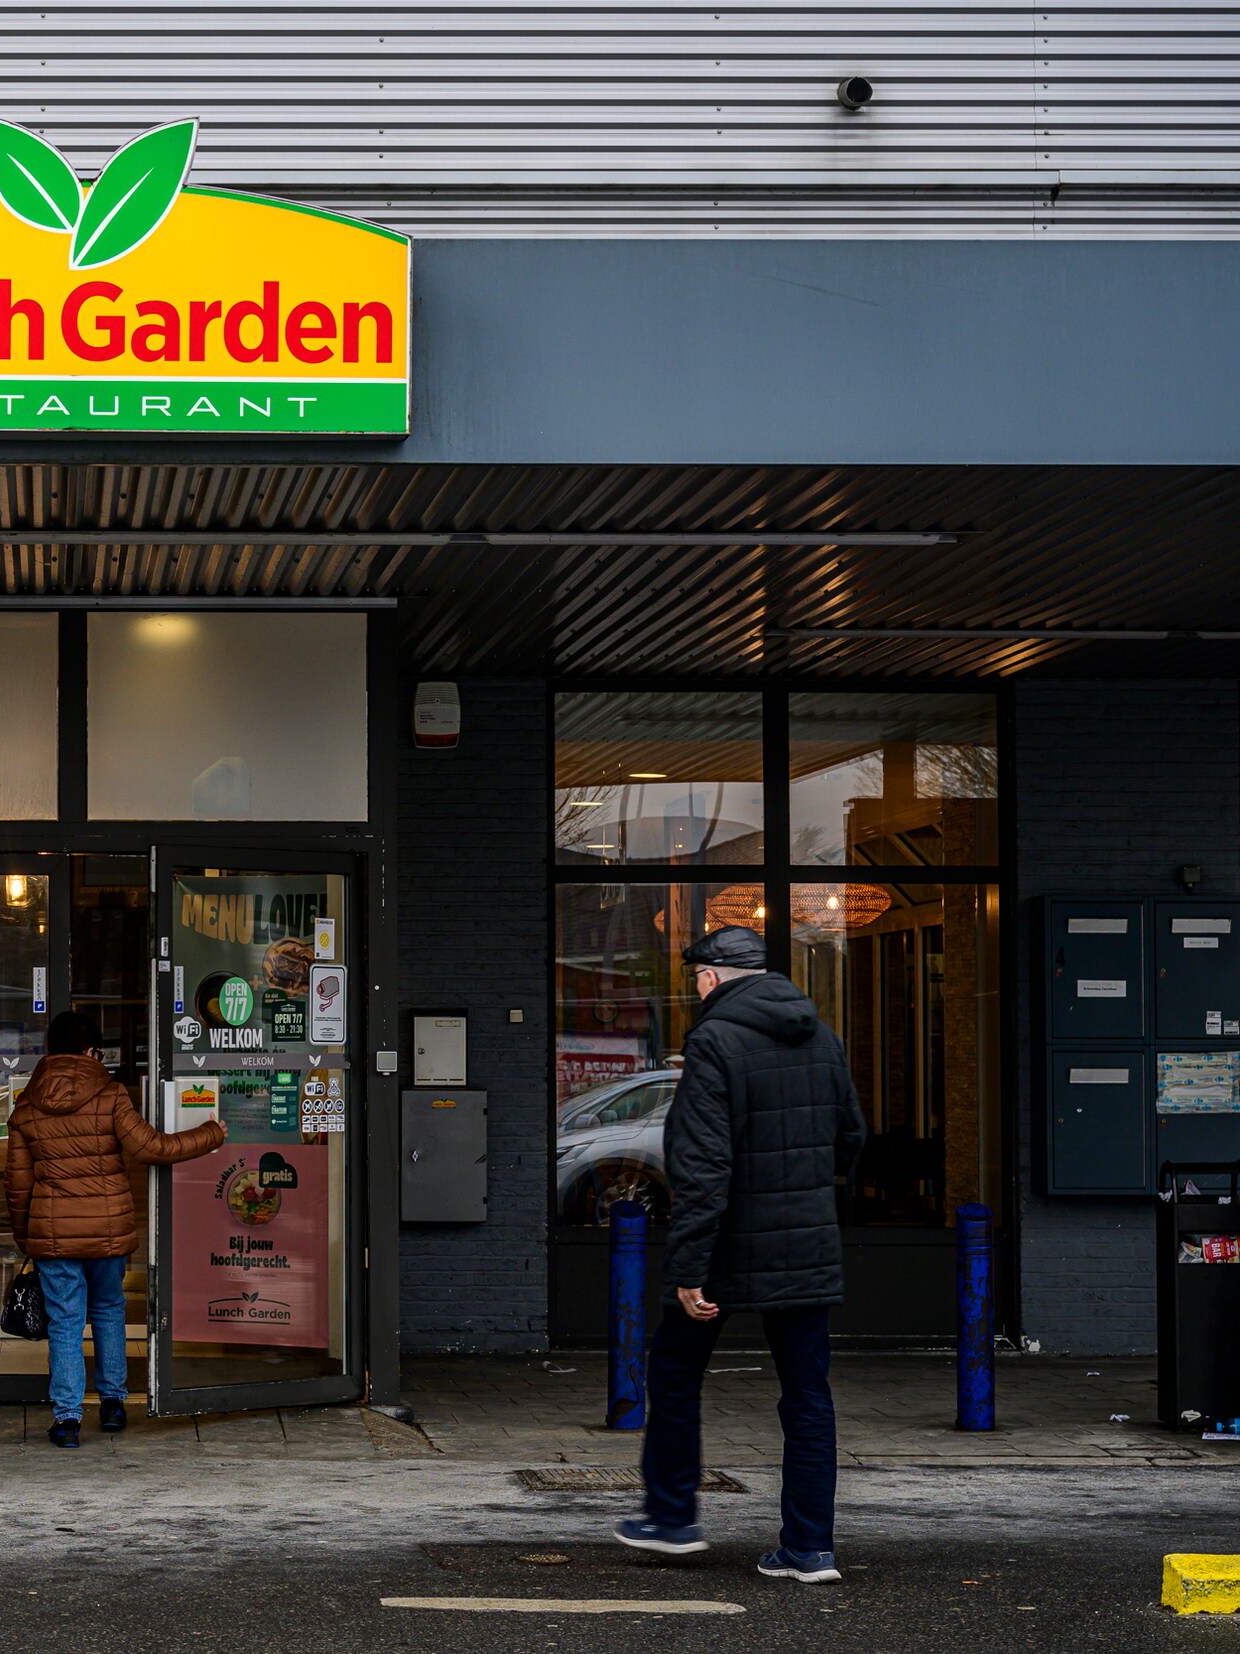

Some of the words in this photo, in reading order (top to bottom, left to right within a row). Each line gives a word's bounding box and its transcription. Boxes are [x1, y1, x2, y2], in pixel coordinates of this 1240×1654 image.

[60, 280, 393, 364] Garden
[225, 983, 247, 997] OPEN
[225, 997, 247, 1021] 7/7
[274, 1013, 291, 1024] OPEN
[292, 1013, 303, 1024] 7/7
[274, 1025, 285, 1034] 8:30
[209, 1028, 263, 1049] WELKOM
[241, 1056, 274, 1066] WELKOM
[214, 1164, 237, 1199] Saladbar
[262, 1168, 294, 1185] gratis
[229, 1235, 244, 1253] Bij
[246, 1235, 273, 1253] jouw
[1212, 1242, 1221, 1257] BAR
[210, 1252, 291, 1271] hoofdgerecht.
[208, 1306, 244, 1317] Lunch
[248, 1307, 291, 1319] Garden
